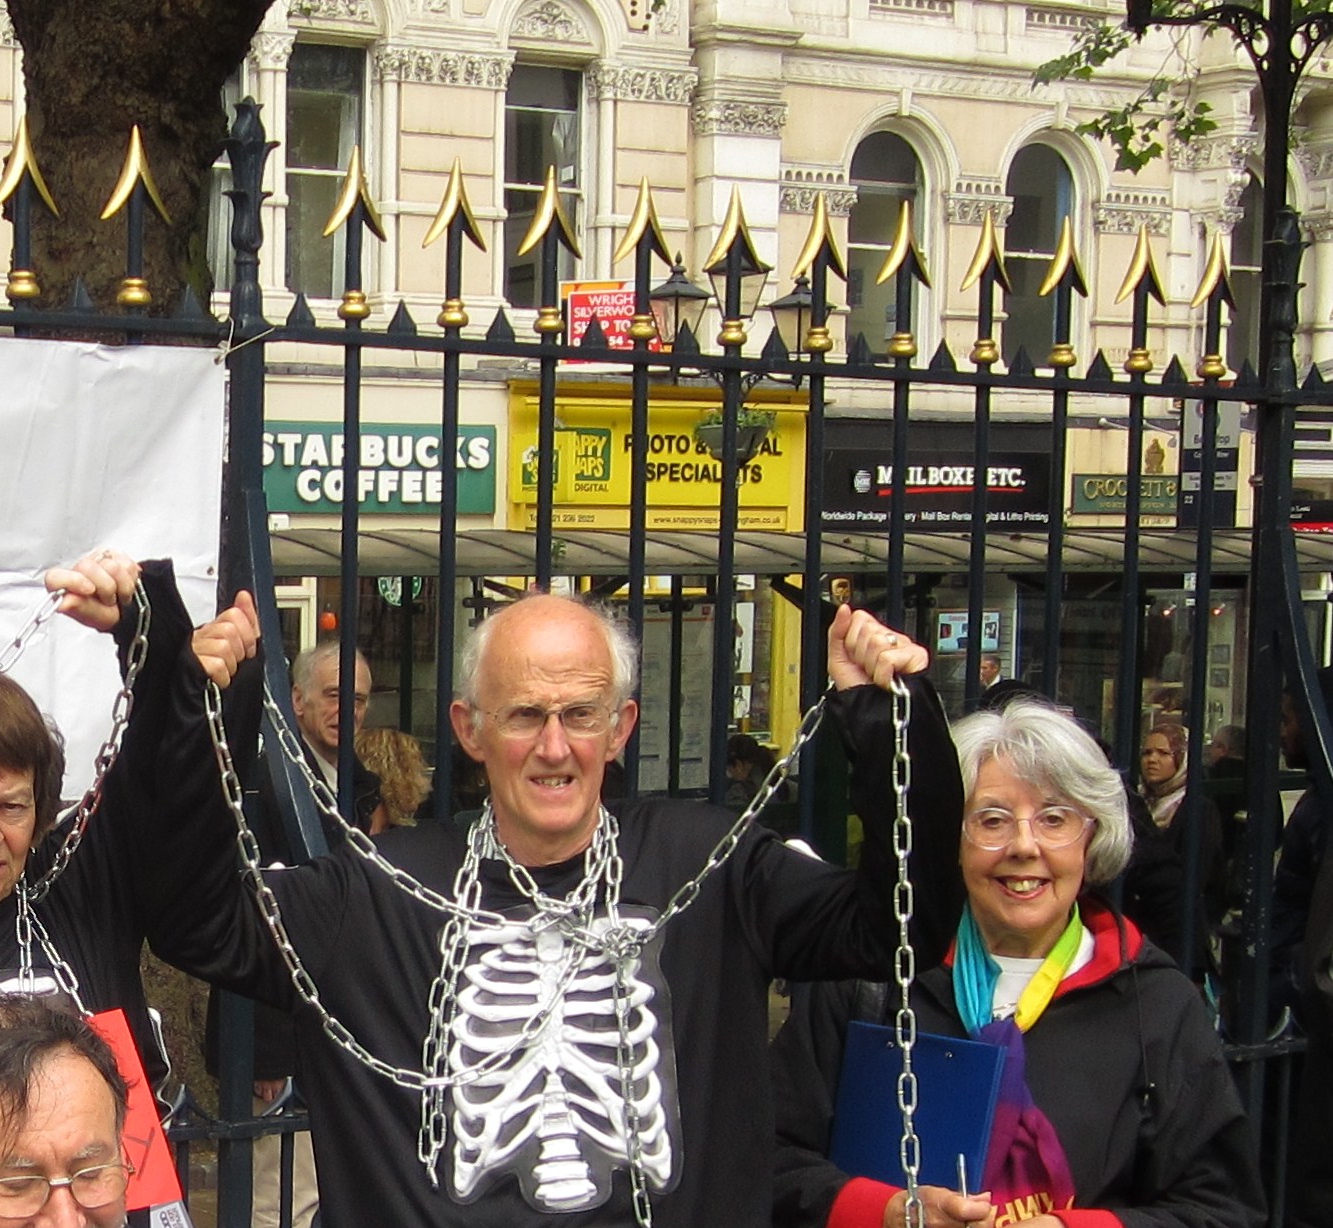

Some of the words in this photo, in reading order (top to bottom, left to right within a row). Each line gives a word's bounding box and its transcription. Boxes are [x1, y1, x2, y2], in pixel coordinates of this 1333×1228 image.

[589, 293, 635, 305] WRIGH
[574, 305, 635, 318] SILVERWO
[574, 320, 609, 334] SHP
[623, 434, 690, 455] POTO
[645, 462, 763, 483] SPECIALTS
[876, 465, 926, 486] MIL
[928, 466, 975, 486] BOXE
[297, 469, 443, 503] COFFEE
[574, 483, 609, 492] DIGITAL
[1083, 478, 1165, 500] CROCETT
